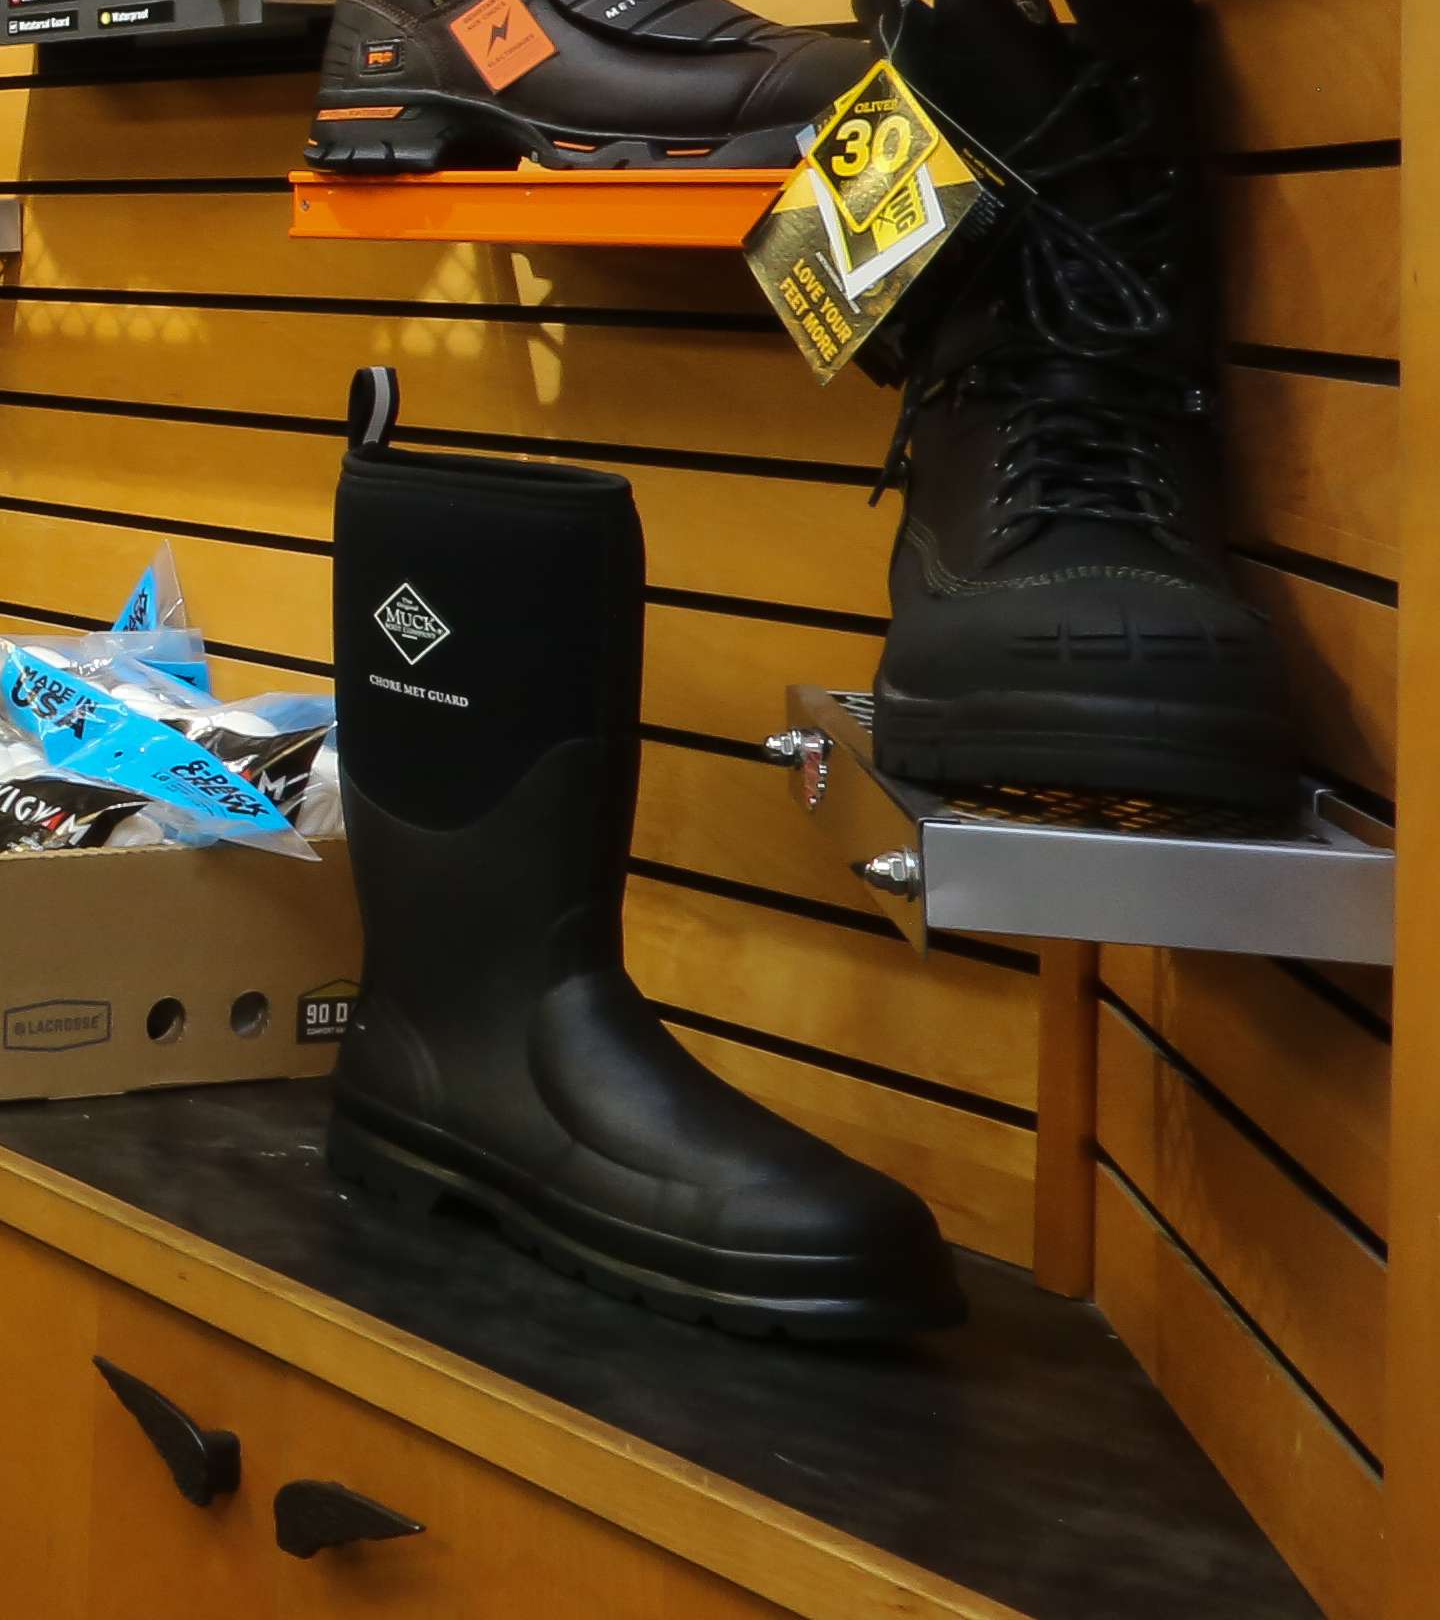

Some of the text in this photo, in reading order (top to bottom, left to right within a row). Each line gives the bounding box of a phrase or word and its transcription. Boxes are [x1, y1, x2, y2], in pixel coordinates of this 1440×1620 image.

[832, 115, 911, 177] 30
[779, 277, 838, 362] FEET MORE
[793, 258, 823, 300] LOVE
[820, 297, 853, 344] YOUR
[386, 606, 437, 632] MUCK
[10, 677, 88, 740] USA
[21, 665, 97, 713] MADE IN
[369, 674, 469, 707] CHORE MET GUARD
[27, 1014, 101, 1035] LACROSSE
[306, 1003, 329, 1024] 90
